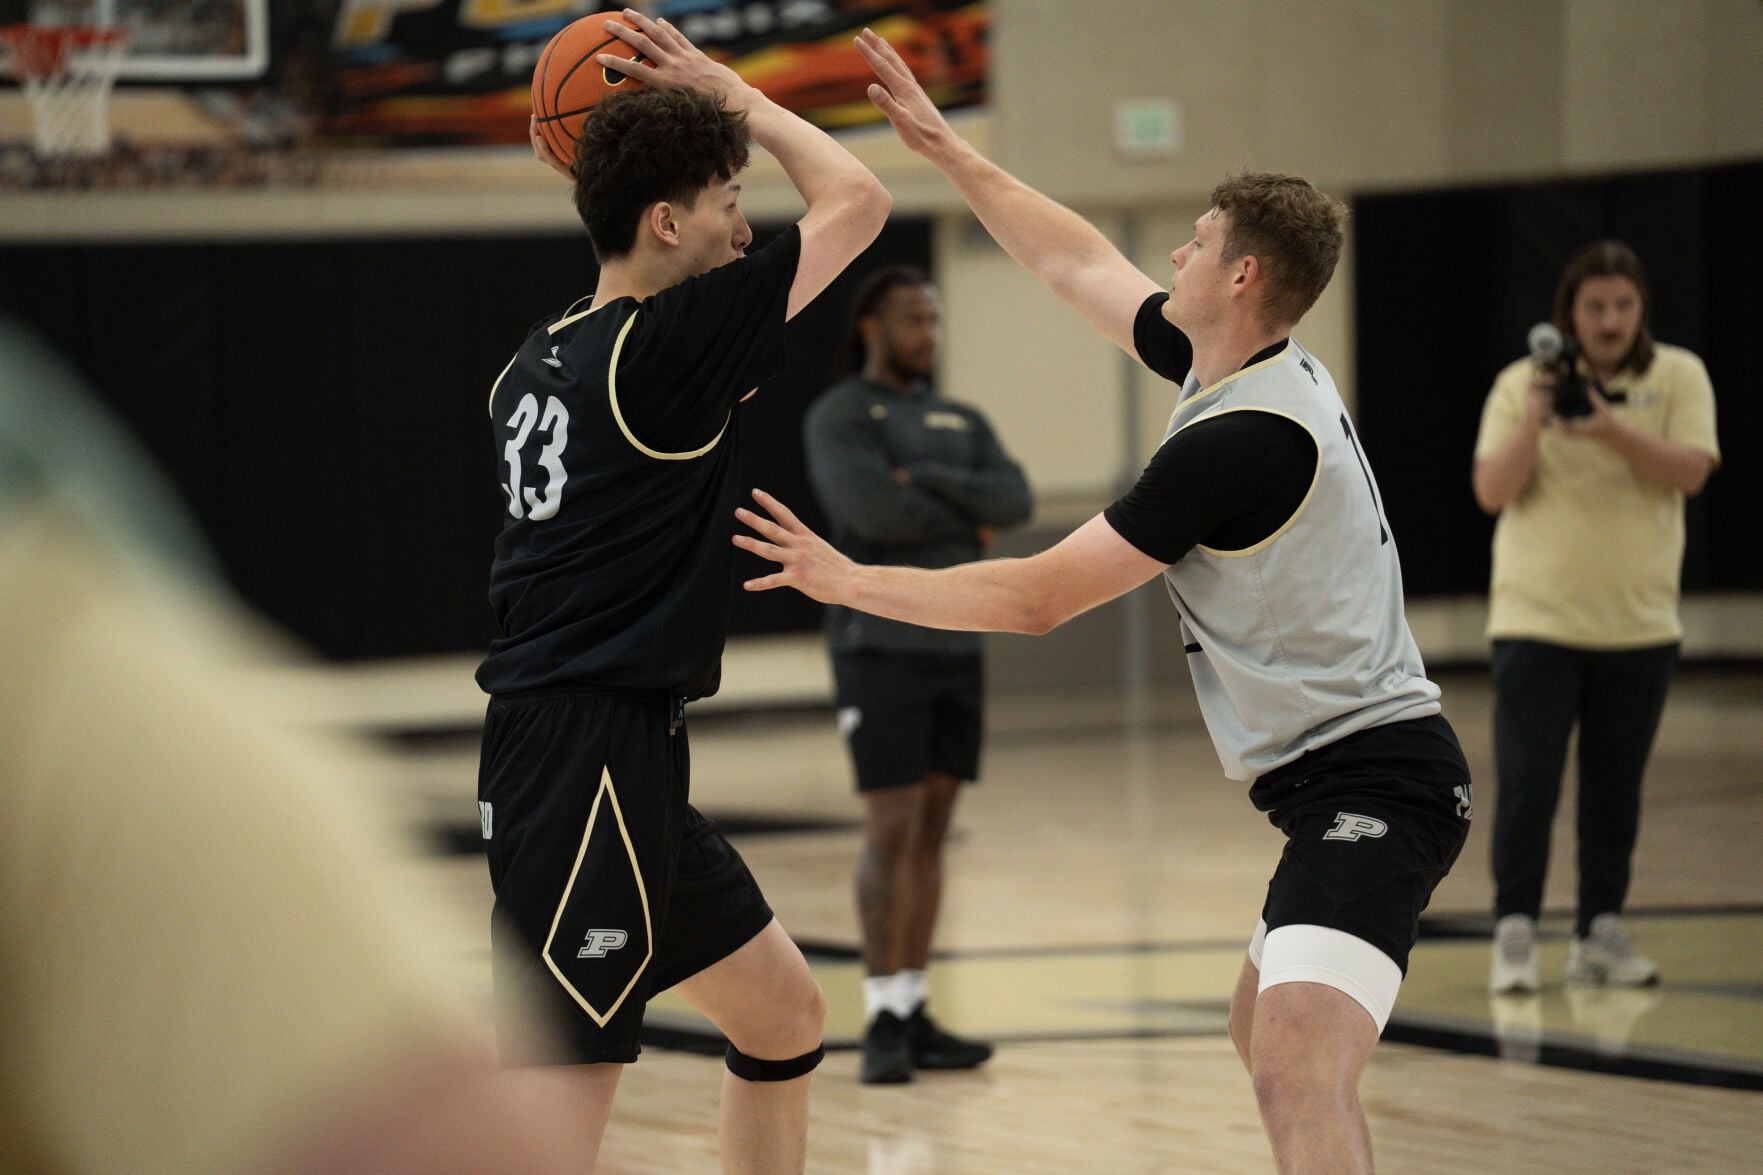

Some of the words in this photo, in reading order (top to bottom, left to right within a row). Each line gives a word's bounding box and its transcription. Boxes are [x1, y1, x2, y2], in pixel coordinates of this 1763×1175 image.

[501, 392, 570, 521] 33
[1322, 811, 1388, 842] P
[576, 928, 628, 958] P
